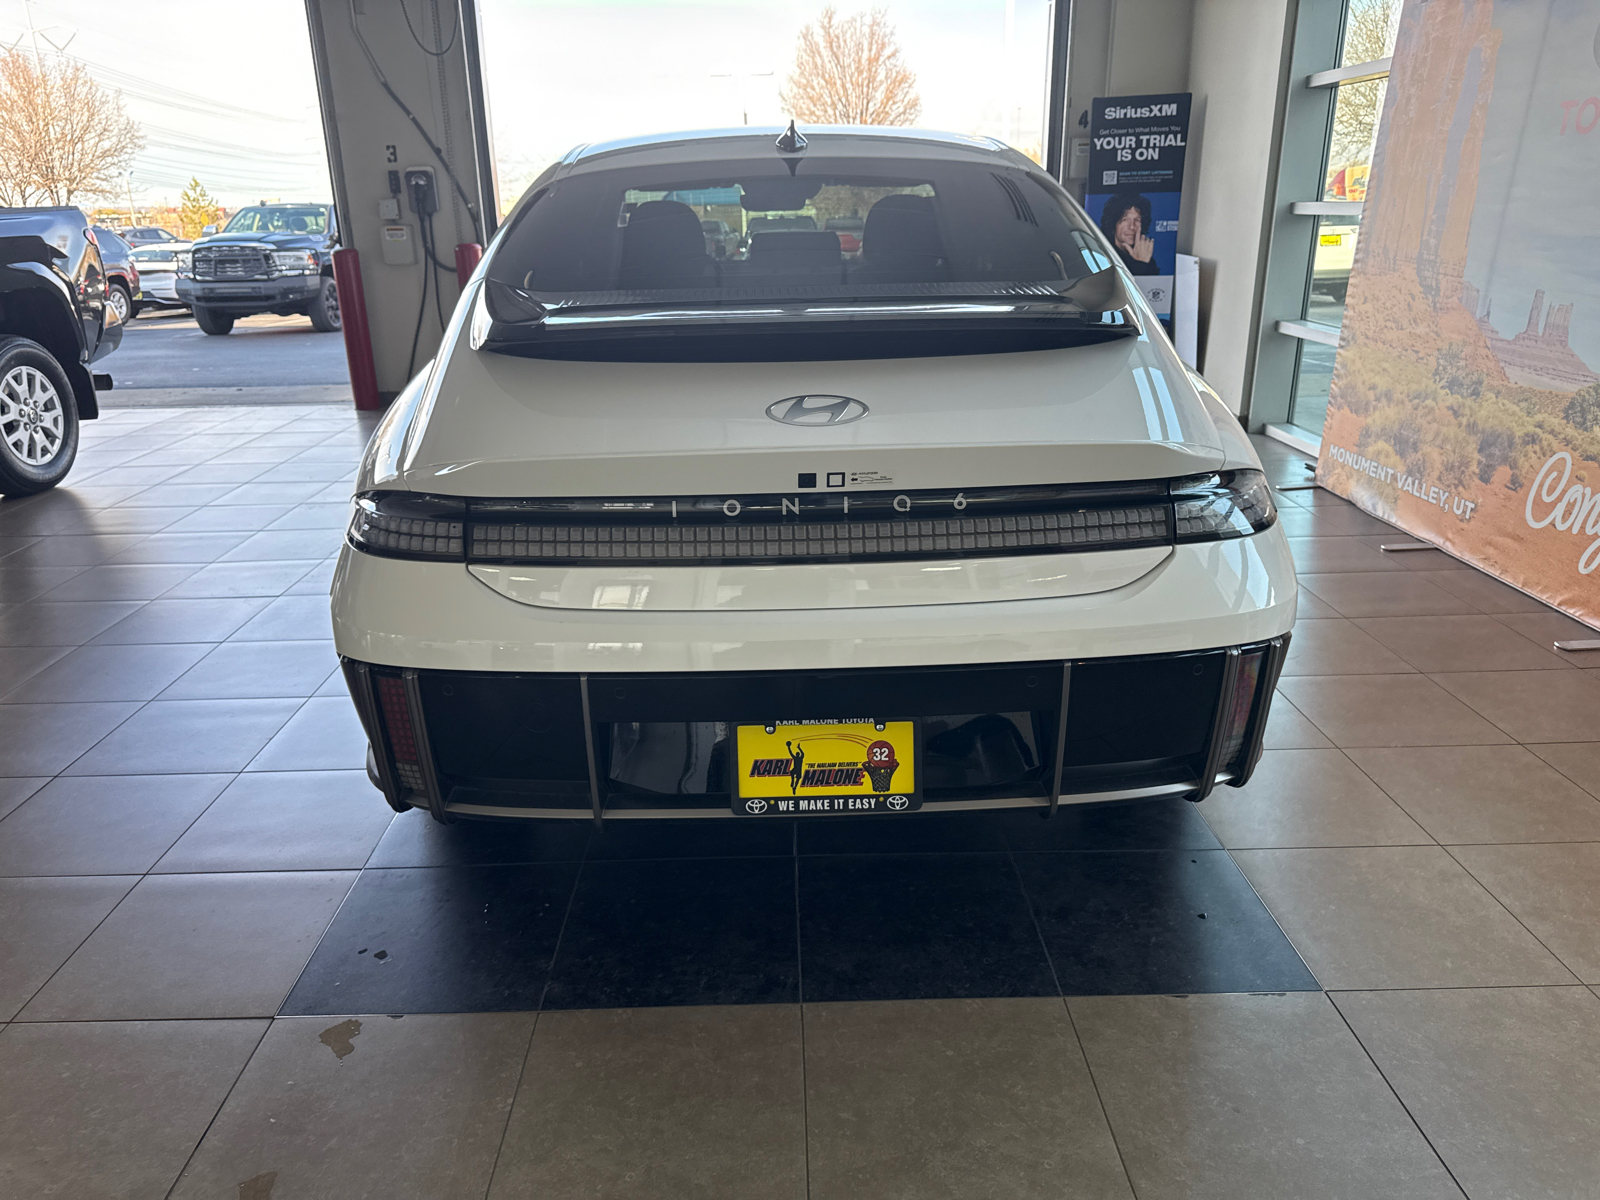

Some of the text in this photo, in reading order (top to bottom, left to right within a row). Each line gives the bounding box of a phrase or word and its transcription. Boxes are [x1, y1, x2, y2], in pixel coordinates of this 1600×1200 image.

[1078, 109, 1089, 129] 4
[1104, 103, 1177, 120] SiriusXM
[1093, 134, 1185, 150] YOUR TRIAL
[386, 145, 398, 163] 3
[1117, 148, 1159, 161] IS ON
[1328, 444, 1476, 519] MONUMENT VALLEY, UT
[671, 492, 967, 517] IONIQ 6
[872, 747, 889, 761] 32
[750, 758, 793, 777] KARL
[800, 767, 865, 787] MALONE
[778, 798, 876, 811] WE MAKE IT EASY
